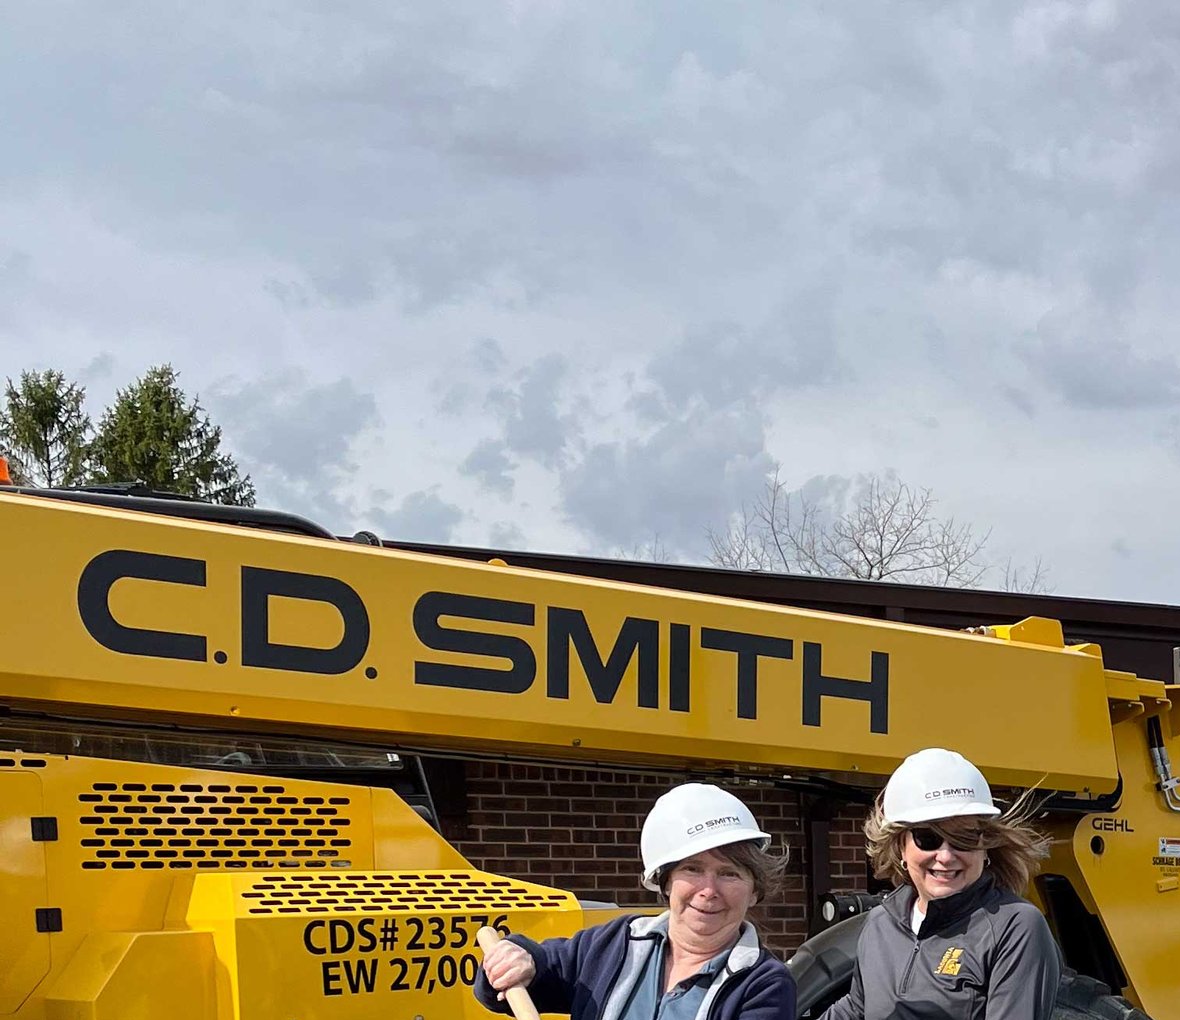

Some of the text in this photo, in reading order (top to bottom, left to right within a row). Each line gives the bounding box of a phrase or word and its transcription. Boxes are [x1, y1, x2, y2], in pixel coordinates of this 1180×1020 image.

[78, 549, 889, 734] C.D. SMITH
[942, 788, 975, 796] SMITH
[705, 816, 740, 828] SMITH
[1092, 817, 1135, 832] GEHL
[303, 918, 399, 955] CDS#
[322, 953, 479, 996] EW 27,00
